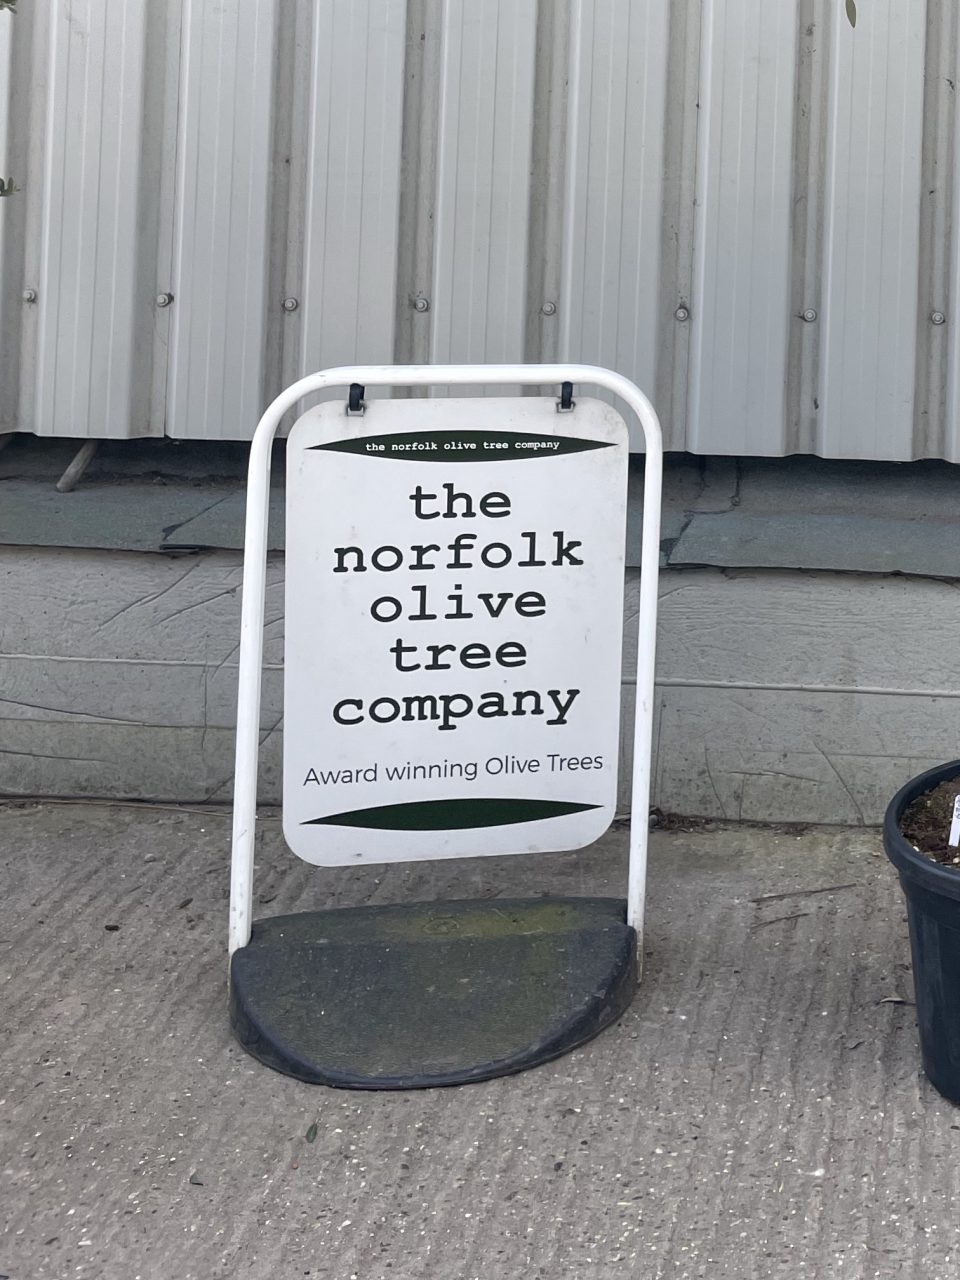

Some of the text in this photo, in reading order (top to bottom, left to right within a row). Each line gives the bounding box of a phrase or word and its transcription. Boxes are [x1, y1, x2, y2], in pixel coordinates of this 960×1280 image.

[365, 439, 561, 452] the norfolk olive tree company
[409, 483, 512, 520] the
[333, 531, 584, 573] norfolk
[371, 584, 546, 622] olive
[390, 638, 527, 672] tree
[332, 688, 581, 731] company
[302, 753, 604, 787] Award winning Olive Trees
